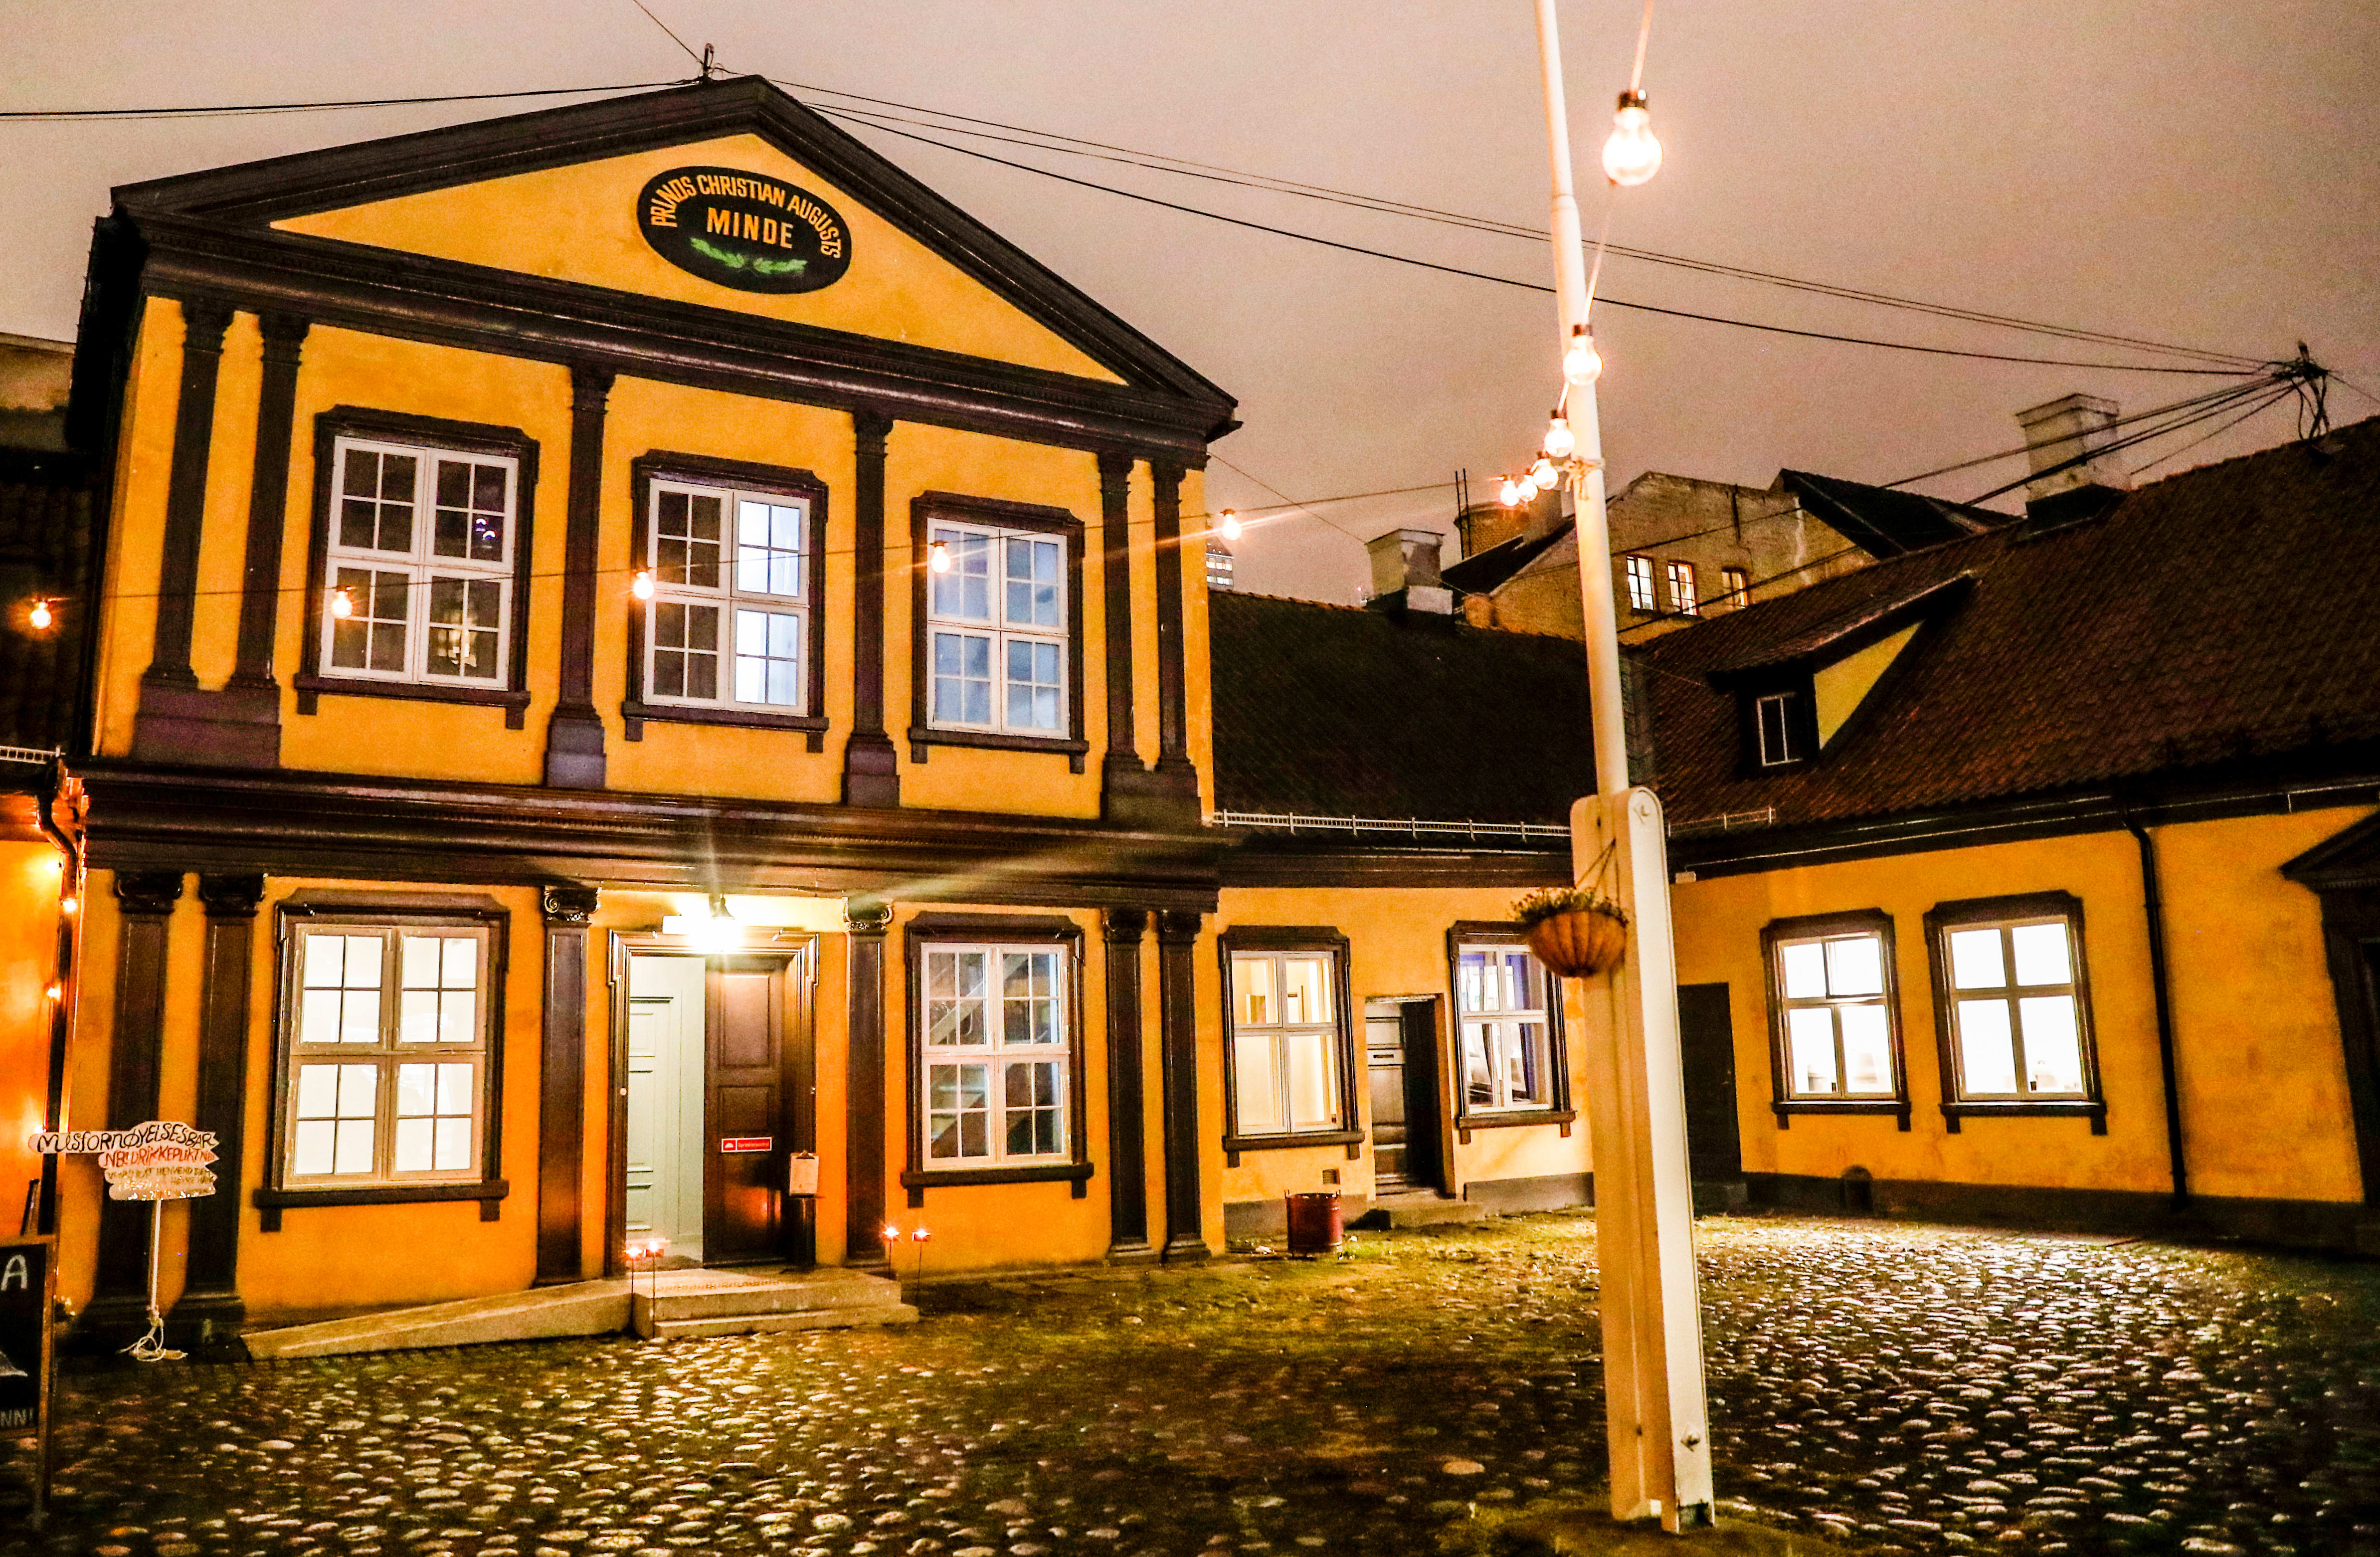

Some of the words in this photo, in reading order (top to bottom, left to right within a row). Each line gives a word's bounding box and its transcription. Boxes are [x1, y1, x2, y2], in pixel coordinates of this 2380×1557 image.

[650, 176, 697, 227] PRINDS
[696, 175, 786, 208] CHRISTIAN
[787, 195, 841, 259] AUGUSTS
[707, 207, 793, 249] MINDE
